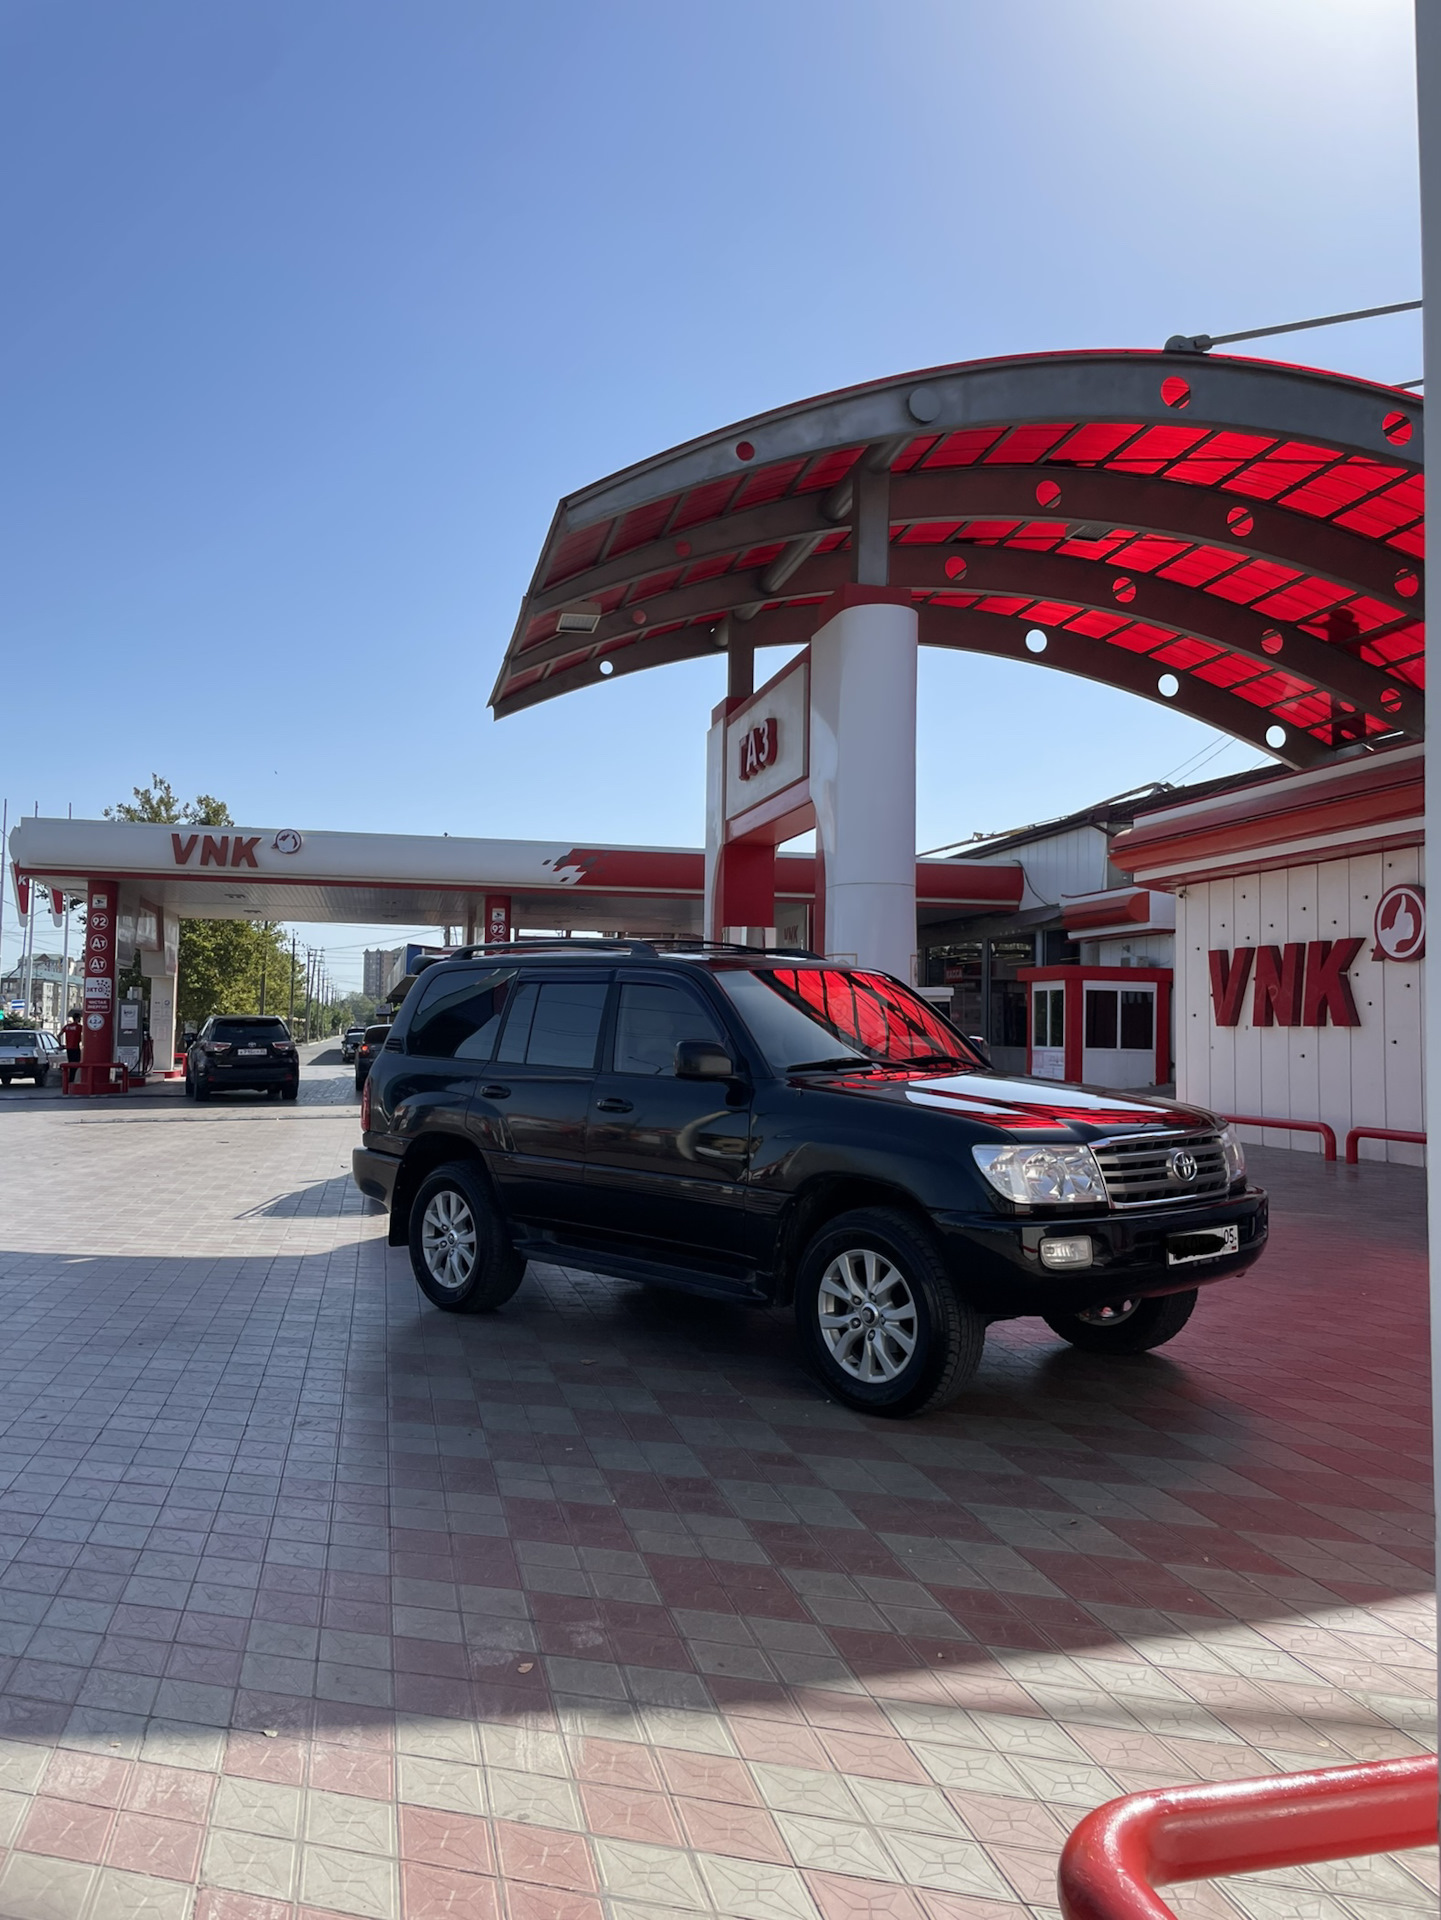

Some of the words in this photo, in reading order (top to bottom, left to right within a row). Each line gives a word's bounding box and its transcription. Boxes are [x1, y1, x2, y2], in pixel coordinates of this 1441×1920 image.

[171, 833, 262, 868] VNK
[93, 917, 106, 926] 92
[492, 925, 504, 933] 92
[1208, 937, 1367, 1027] VNK
[1224, 1228, 1234, 1245] 05
